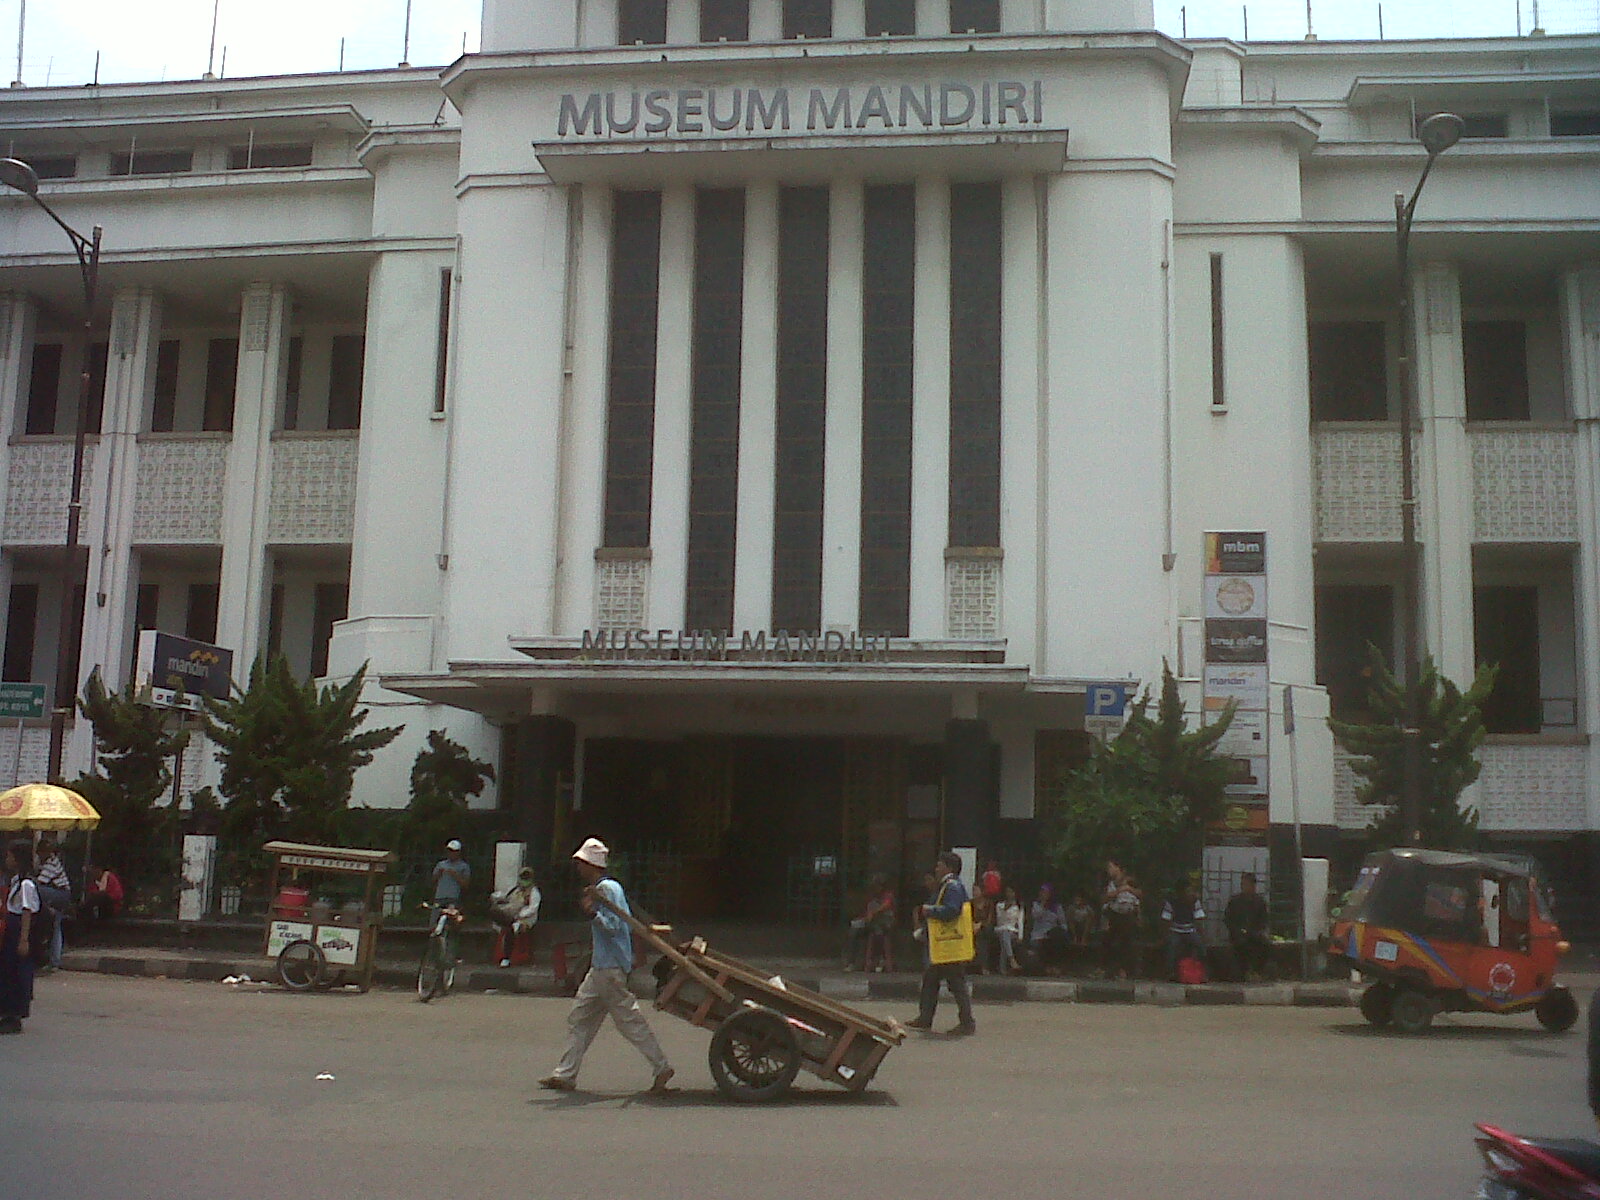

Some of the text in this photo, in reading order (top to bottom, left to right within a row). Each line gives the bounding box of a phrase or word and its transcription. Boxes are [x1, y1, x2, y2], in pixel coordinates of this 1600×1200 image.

[557, 80, 1043, 136] MUSEUM MANDIRI
[1223, 541, 1260, 553] mbm
[582, 629, 891, 653] MUSEUM MANDIRI
[1094, 688, 1116, 715] P
